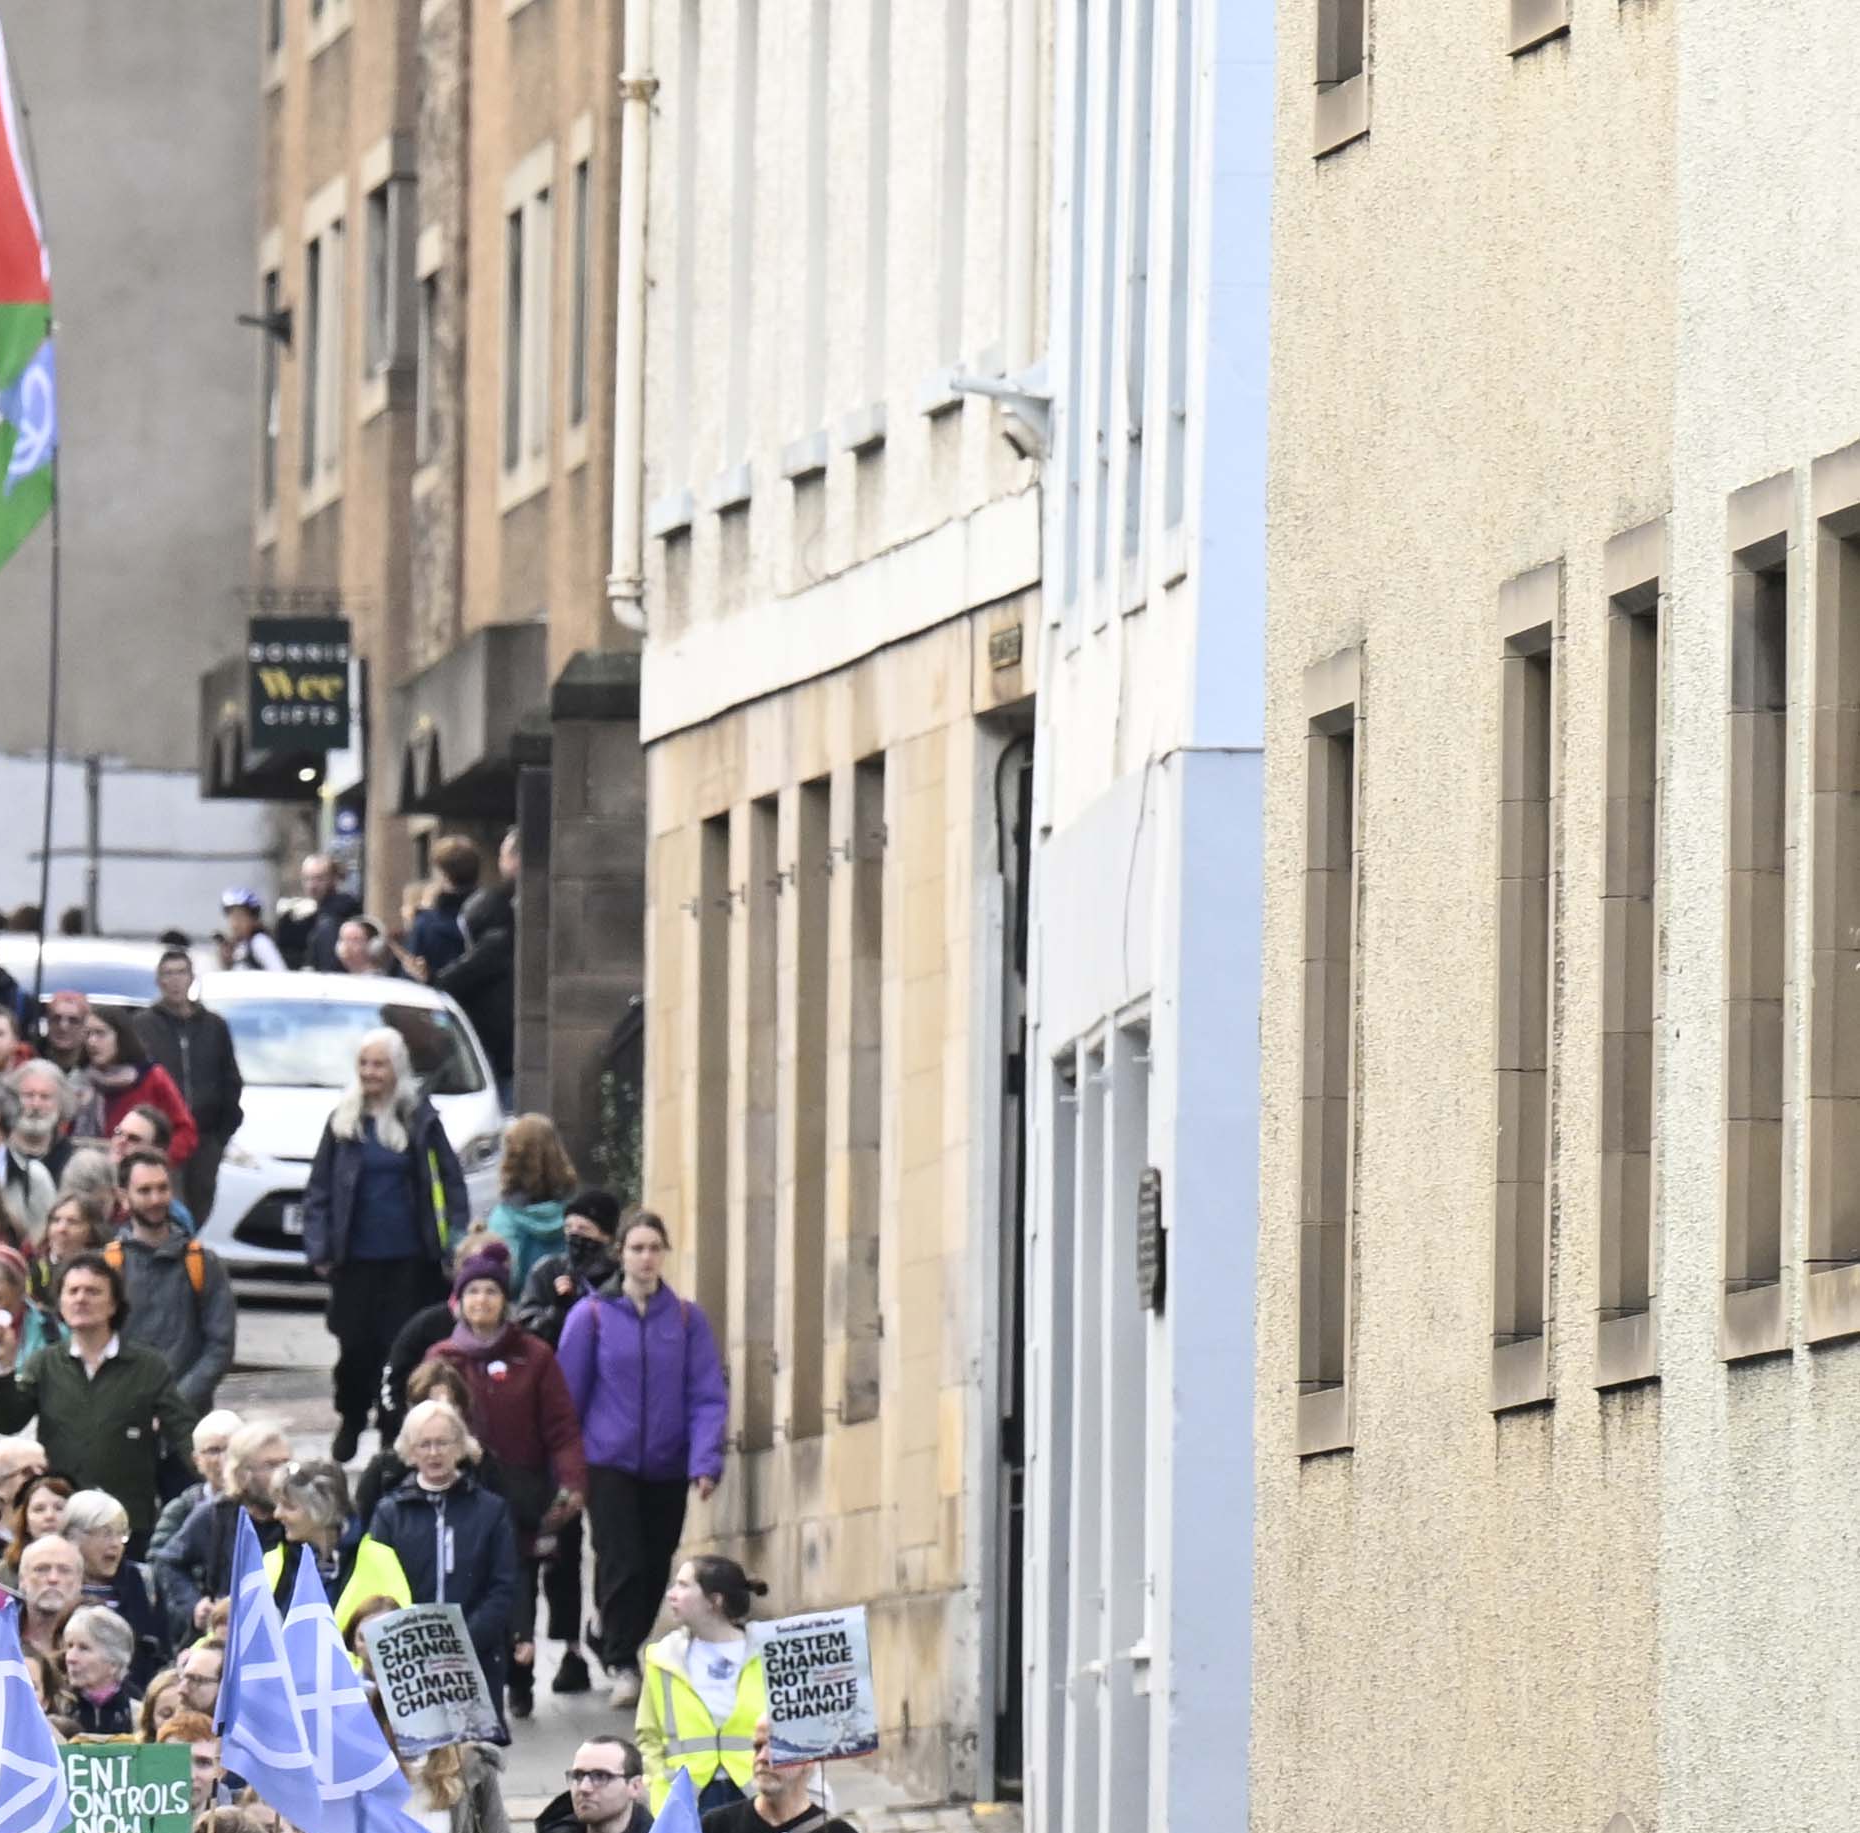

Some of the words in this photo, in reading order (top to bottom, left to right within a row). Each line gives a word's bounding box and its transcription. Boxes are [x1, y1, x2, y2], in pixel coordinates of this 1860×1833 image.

[261, 705, 338, 725] GIFTS
[377, 1623, 456, 1655] SYSTEM
[764, 1631, 847, 1658] SYSTEM
[382, 1639, 464, 1669] CHANGE
[766, 1646, 852, 1673] CHANGE
[386, 1659, 425, 1686] NOT
[391, 1670, 477, 1701] CLIMATE
[769, 1670, 809, 1689] NOT
[397, 1686, 480, 1717] CHANGE
[770, 1678, 858, 1705] CLIMATE
[771, 1695, 857, 1722] CHANGE
[67, 1754, 130, 1785] ENT
[69, 1781, 189, 1816] ONTROLS
